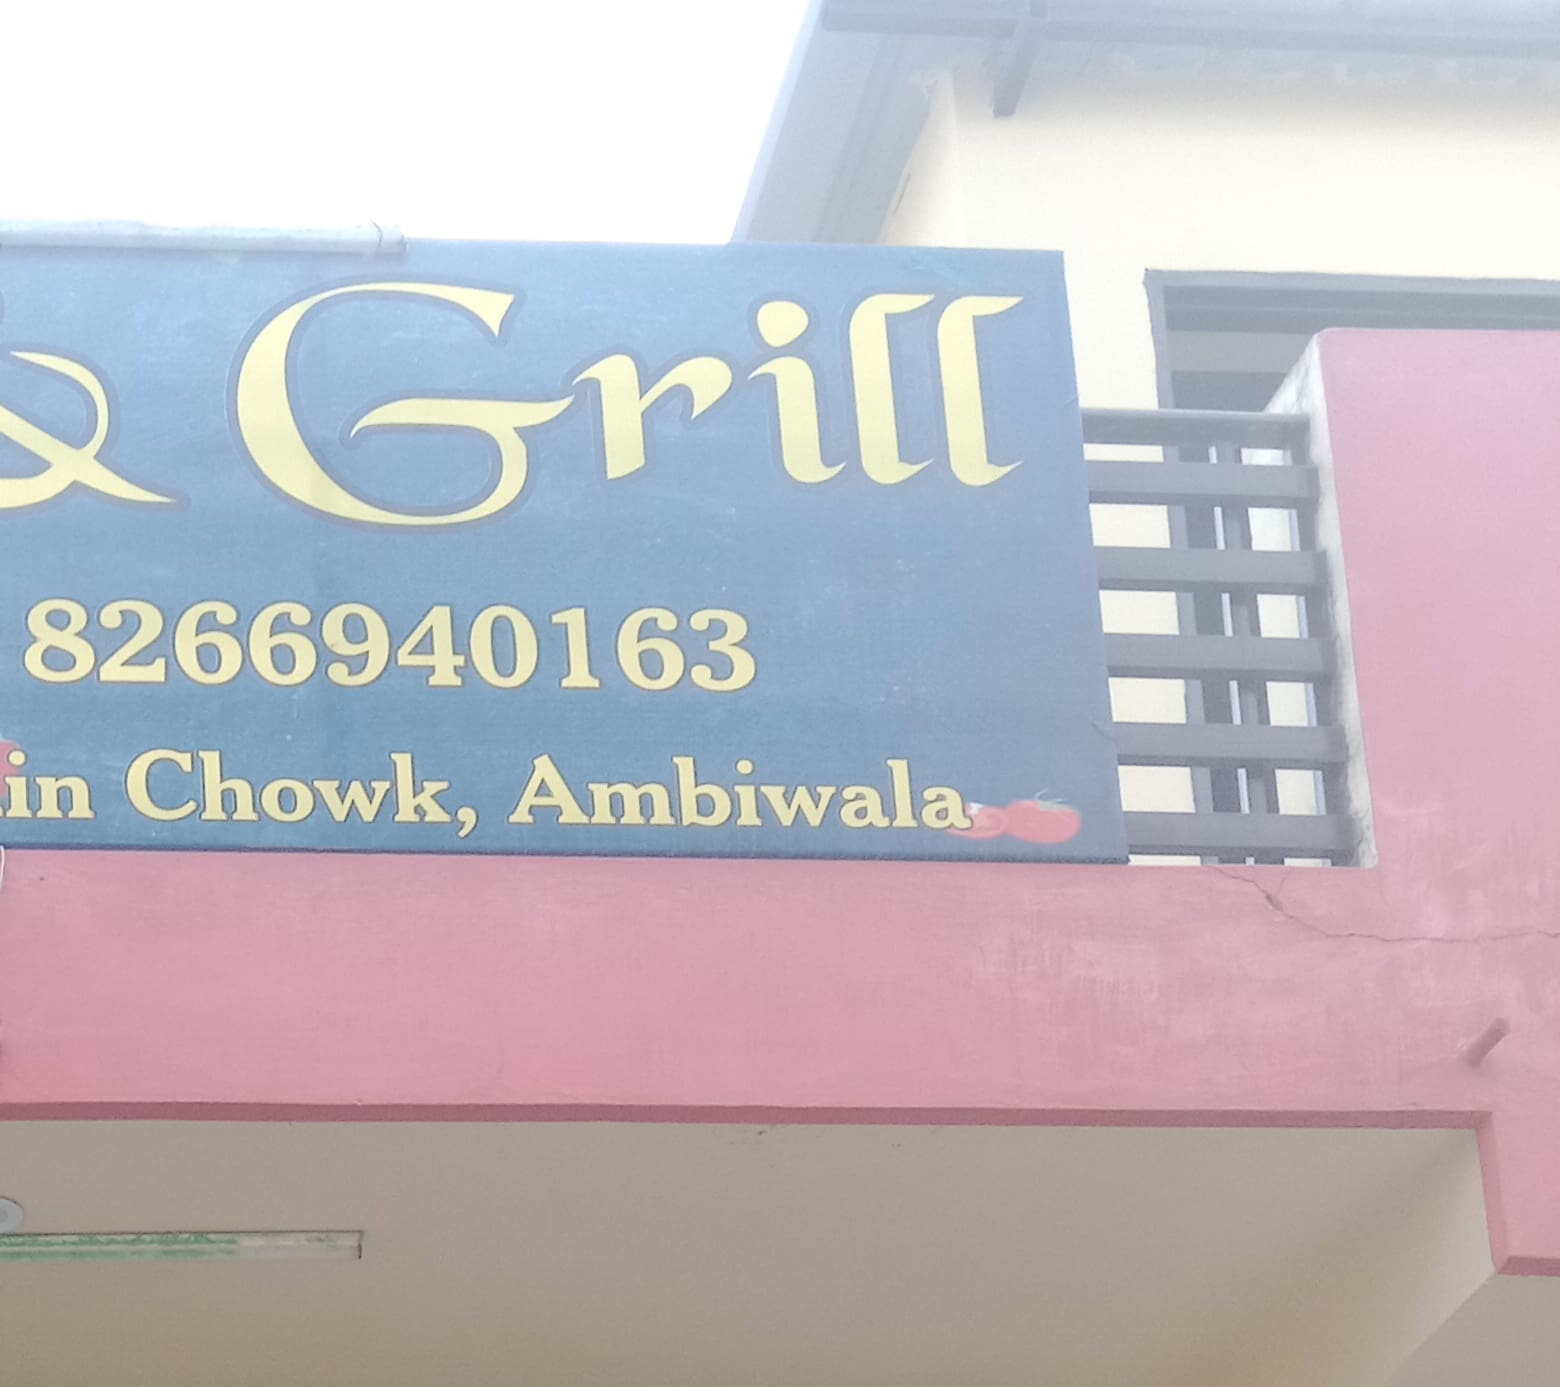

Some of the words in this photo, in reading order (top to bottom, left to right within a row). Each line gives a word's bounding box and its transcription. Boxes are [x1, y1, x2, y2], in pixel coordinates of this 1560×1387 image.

[237, 283, 1019, 526] Grill
[23, 598, 757, 693] 8266940163
[125, 749, 478, 838] Chowk,
[508, 755, 973, 832] Ambiwala
